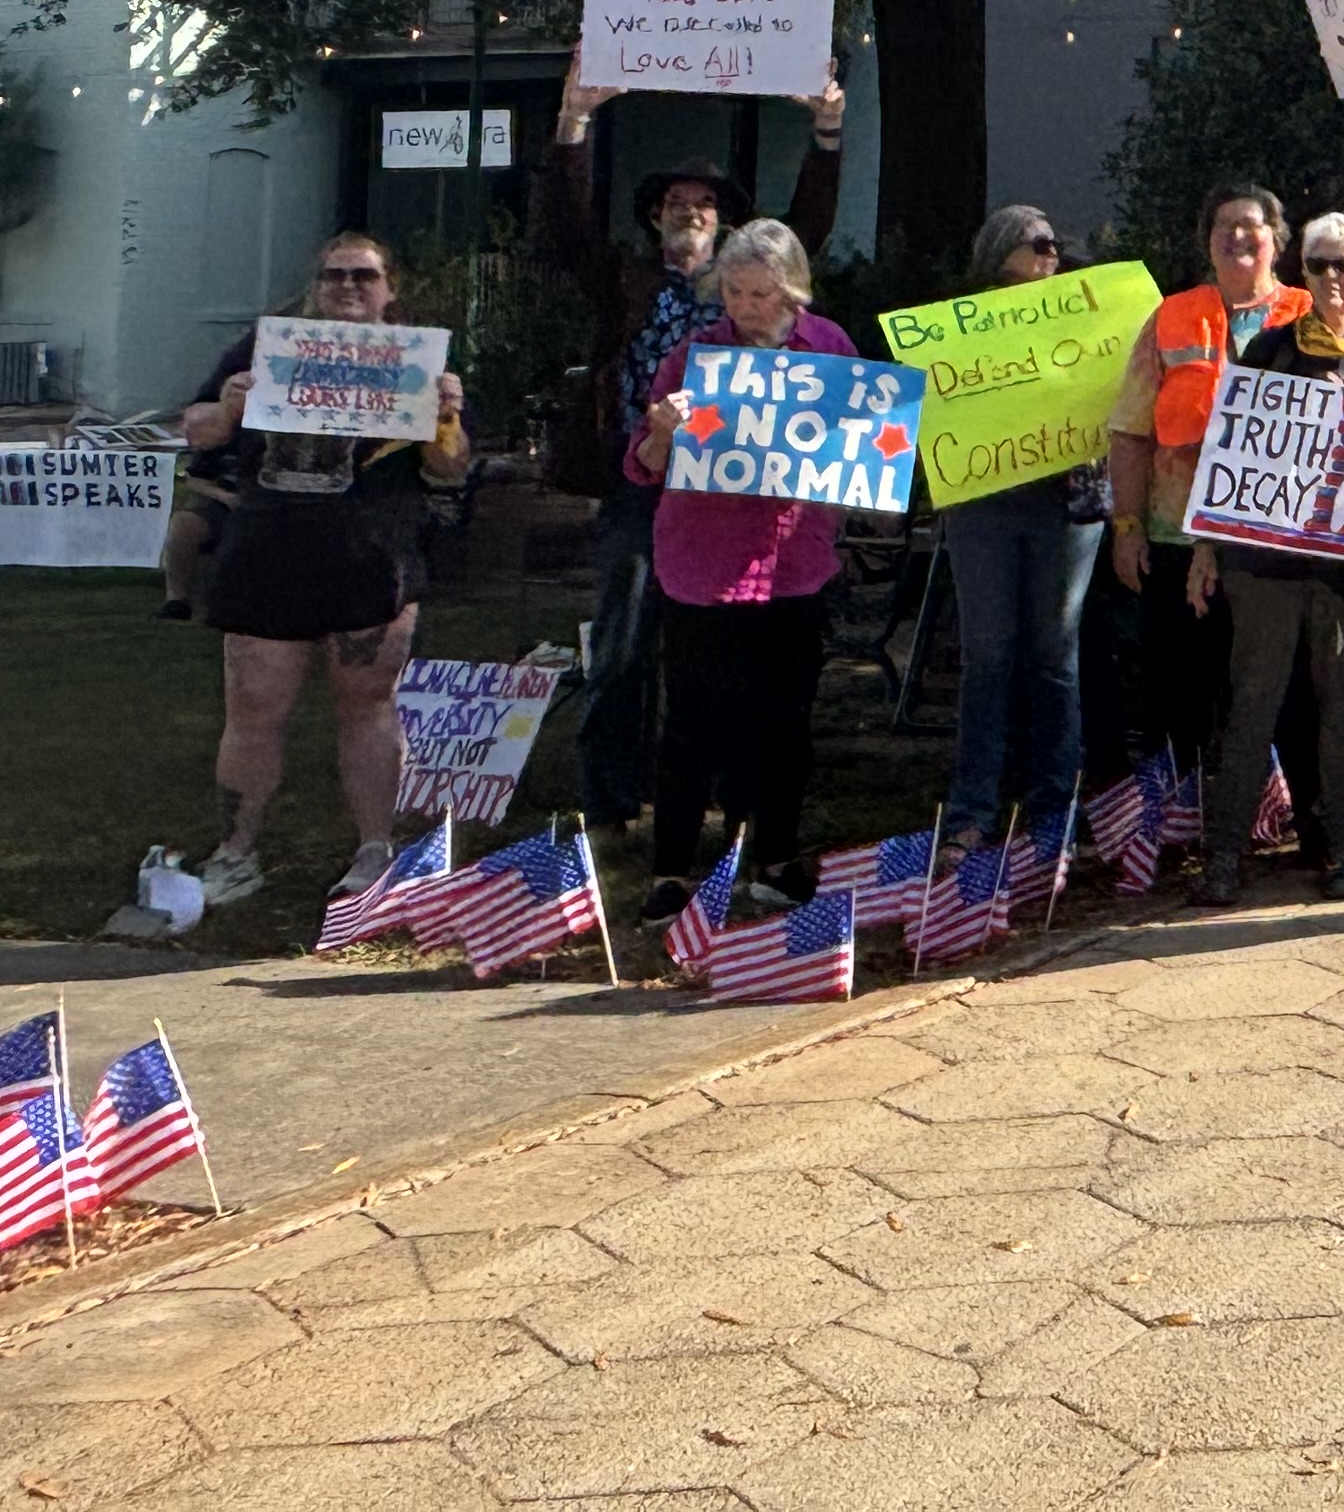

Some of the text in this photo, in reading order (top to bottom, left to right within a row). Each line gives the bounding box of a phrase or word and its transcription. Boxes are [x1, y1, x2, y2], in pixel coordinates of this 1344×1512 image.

[621, 40, 692, 73] Love
[389, 128, 443, 146] new
[889, 315, 945, 350] Be
[1224, 375, 1336, 419] FIGHT
[735, 403, 873, 460] NOT
[933, 417, 1107, 487] Constitu
[1218, 412, 1335, 469] TRUTH
[45, 481, 162, 508] SPEAKS
[669, 446, 901, 512] NORMAL
[1204, 463, 1322, 523] DECAY
[450, 737, 498, 767] NOT
